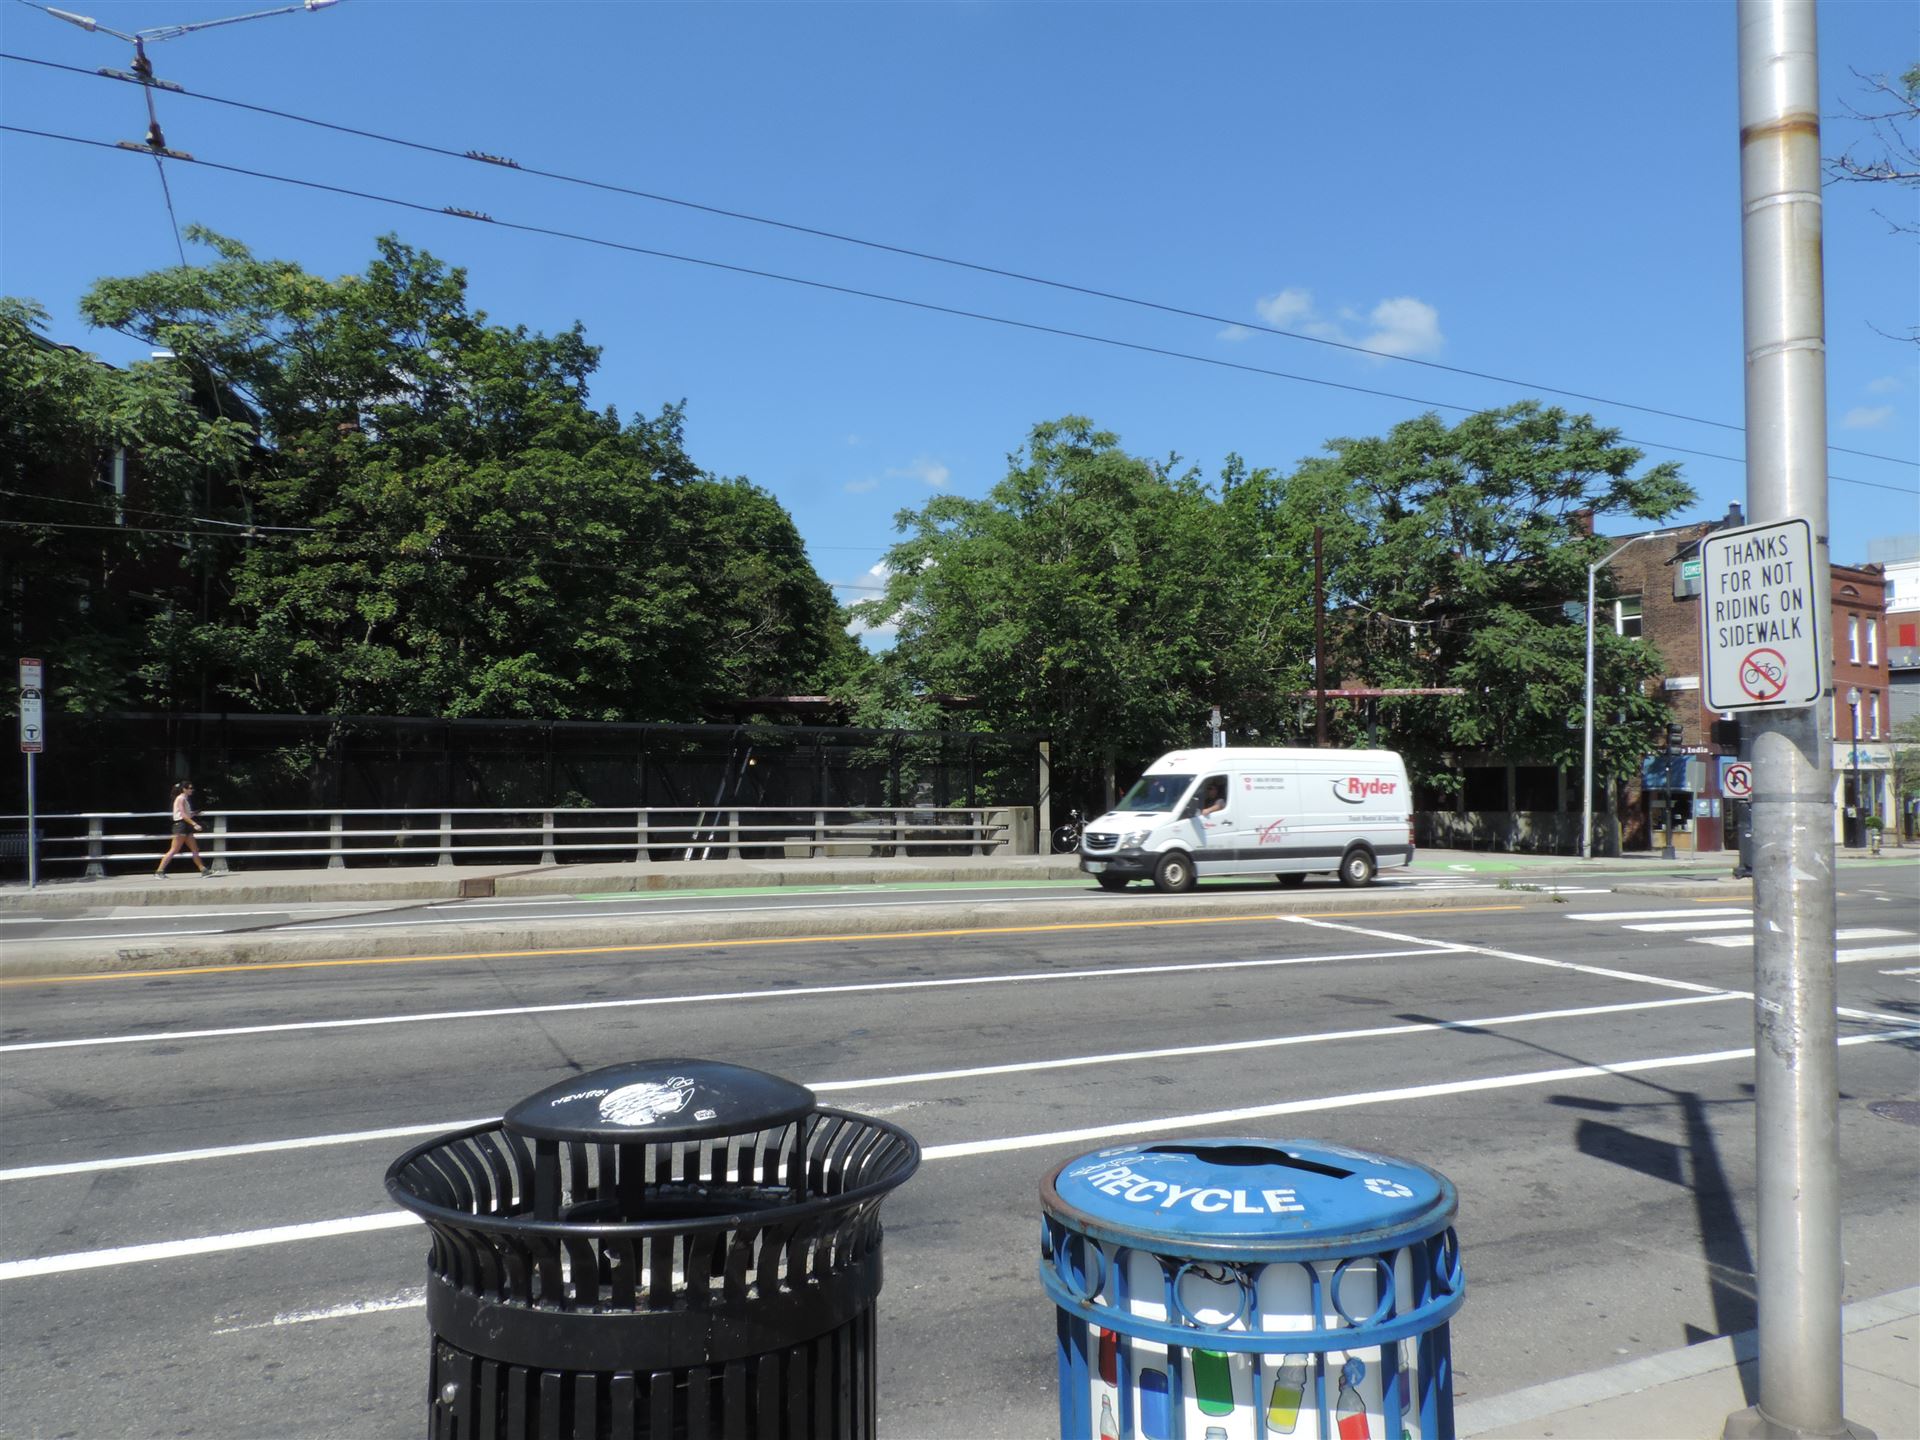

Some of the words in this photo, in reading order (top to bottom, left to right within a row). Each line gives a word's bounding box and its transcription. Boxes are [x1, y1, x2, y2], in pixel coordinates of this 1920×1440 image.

[1724, 534, 1789, 567] THANKS
[1721, 569, 1751, 594] FOR
[1762, 561, 1793, 587] NOT
[1716, 594, 1770, 622] RIDING
[1780, 588, 1803, 612] ON
[1719, 617, 1802, 648] SIDEWALK
[1687, 746, 1708, 754] India
[1348, 777, 1397, 798] Ryder
[1087, 1166, 1305, 1214] RECYCLE
